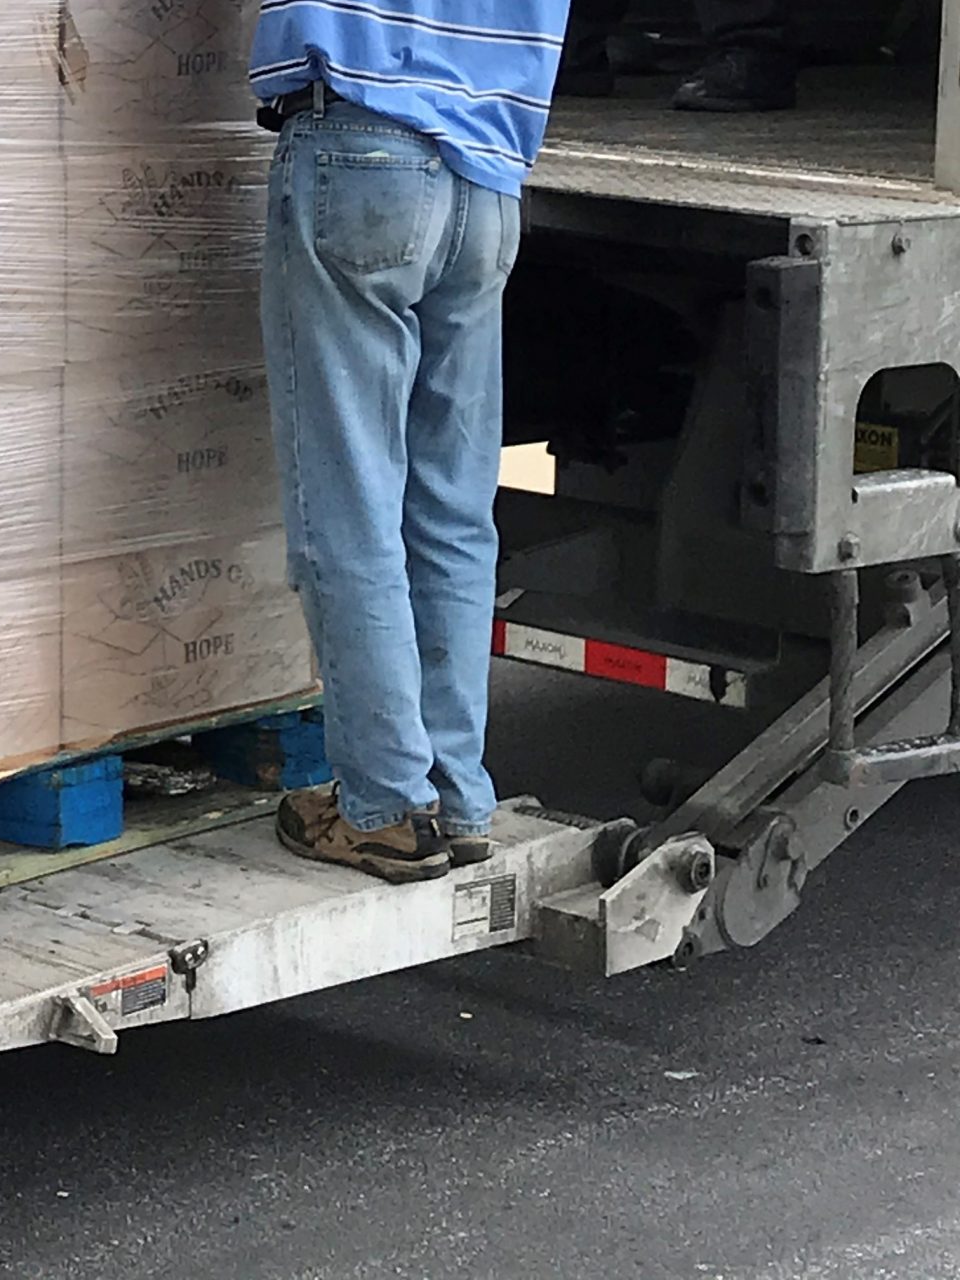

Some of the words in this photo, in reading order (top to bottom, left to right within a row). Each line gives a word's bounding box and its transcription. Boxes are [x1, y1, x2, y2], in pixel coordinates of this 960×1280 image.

[855, 429, 893, 447] XON
[177, 447, 228, 473] HOPE
[153, 559, 222, 613] HANDS
[183, 633, 236, 664] HOPE
